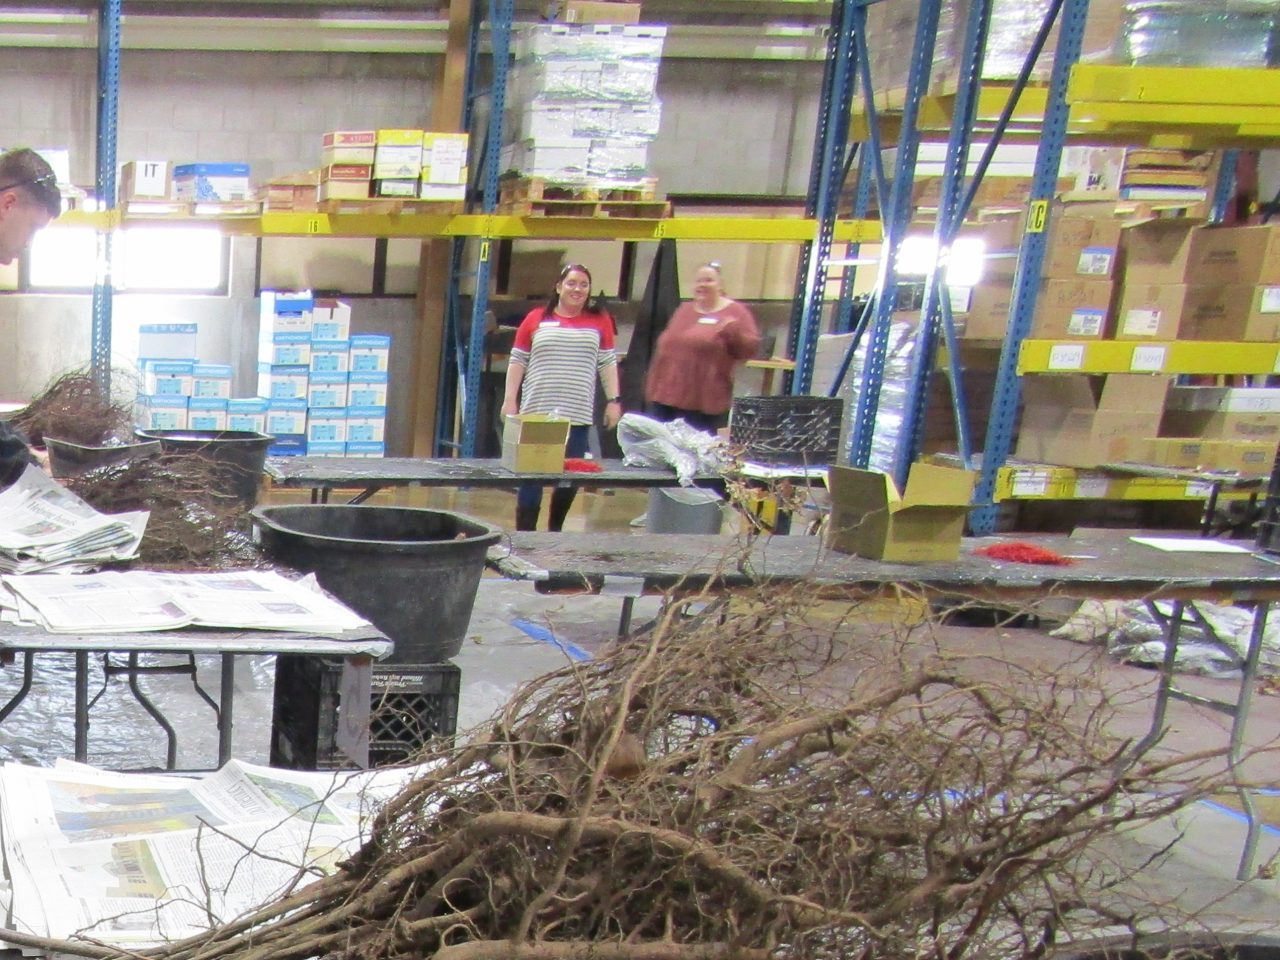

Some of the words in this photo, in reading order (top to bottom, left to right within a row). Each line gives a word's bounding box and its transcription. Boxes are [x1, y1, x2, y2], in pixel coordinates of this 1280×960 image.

[144, 163, 159, 178] IT
[1034, 204, 1045, 229] C
[309, 220, 318, 233] 16
